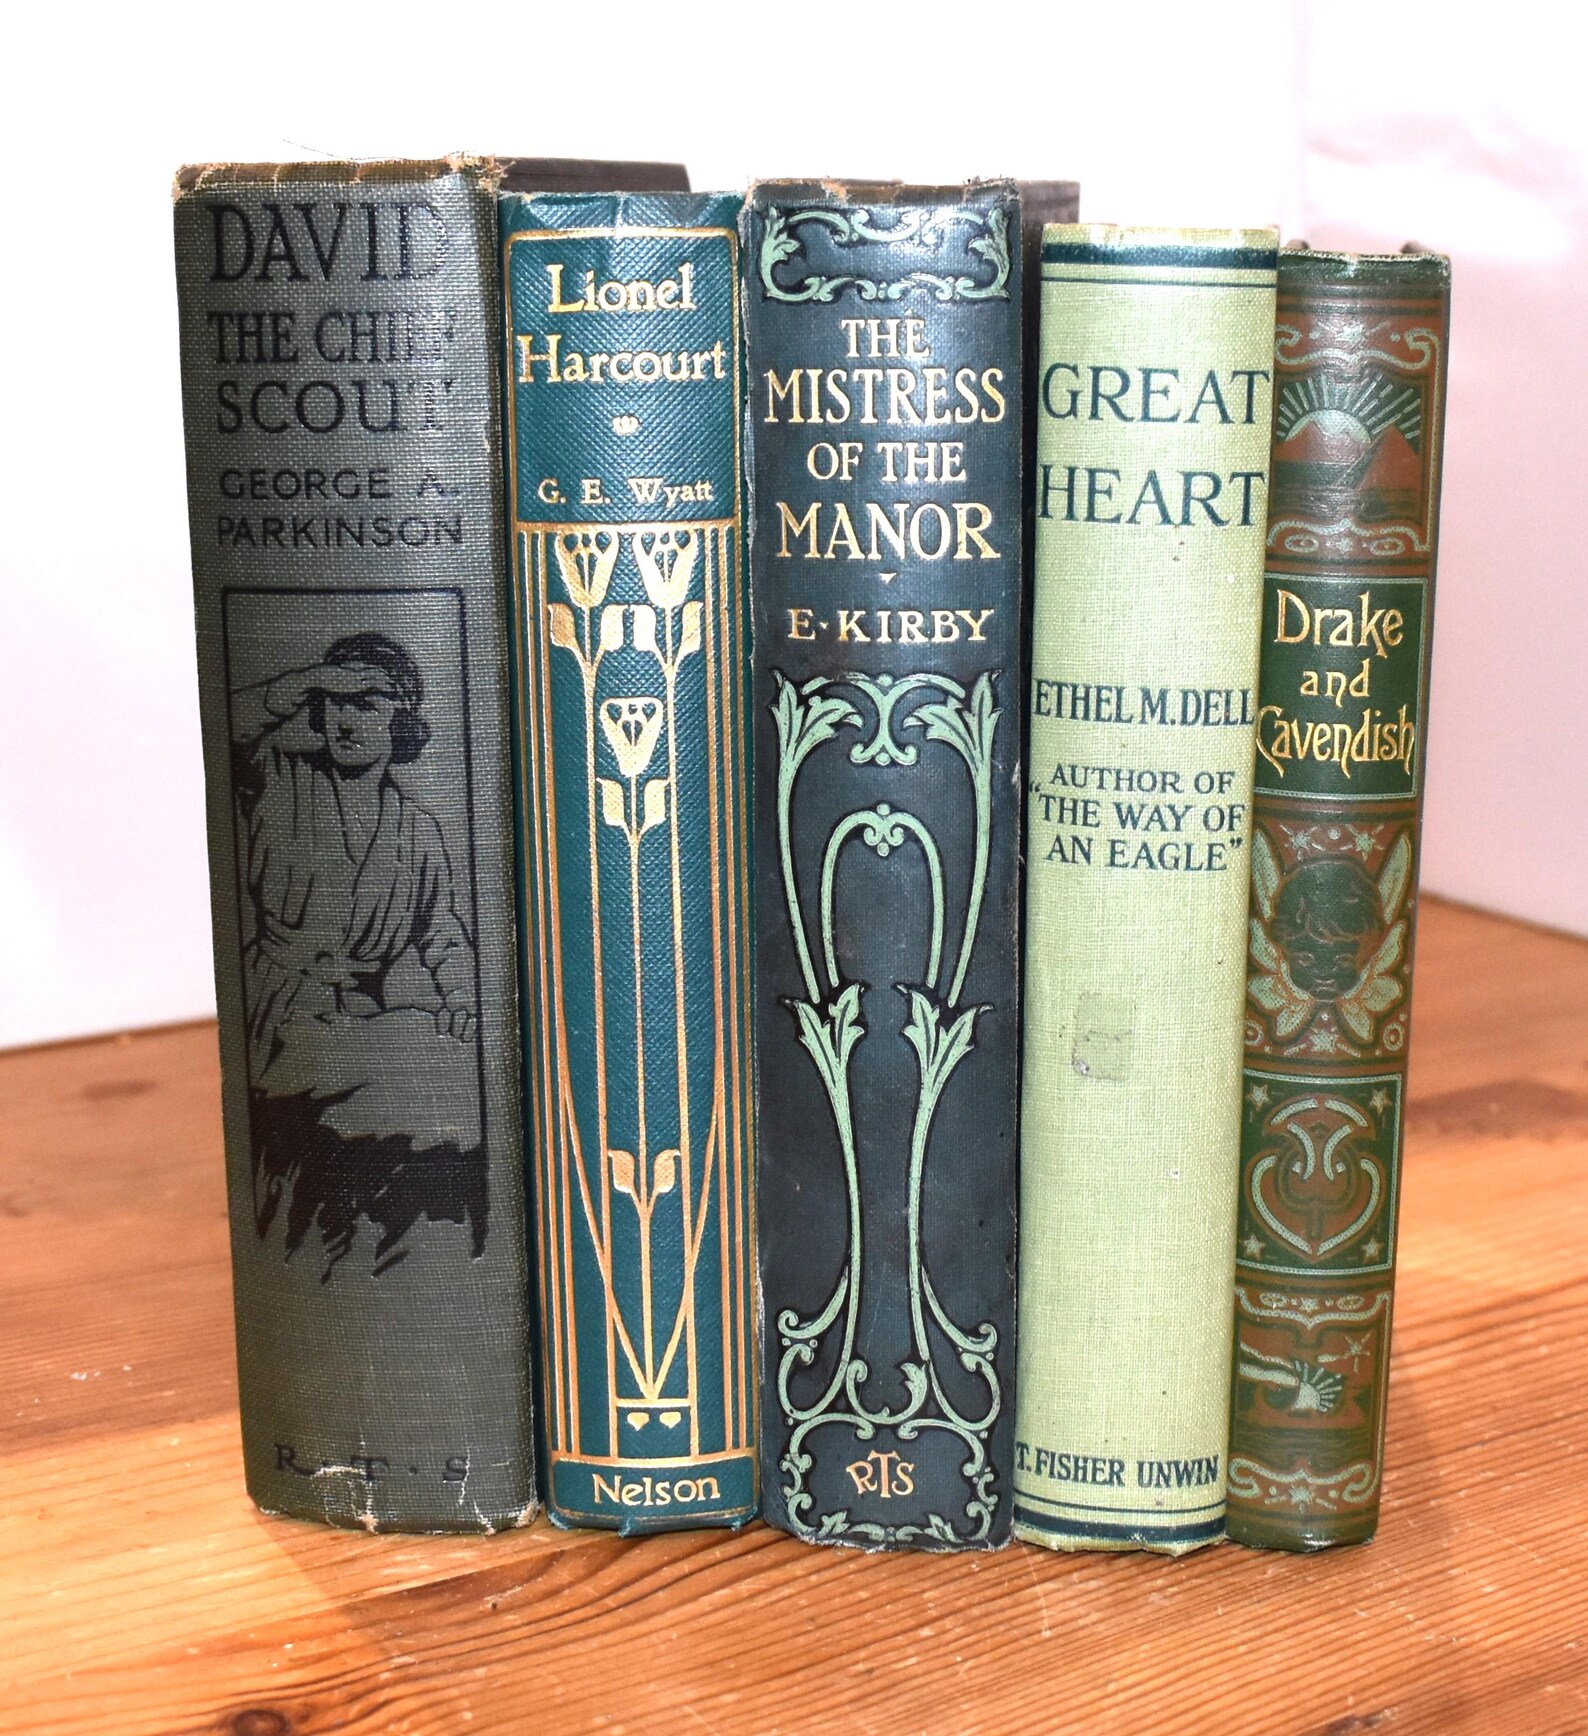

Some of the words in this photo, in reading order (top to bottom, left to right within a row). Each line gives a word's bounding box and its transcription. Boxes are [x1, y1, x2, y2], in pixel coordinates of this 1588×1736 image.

[206, 201, 449, 281] DAVID
[547, 262, 696, 312] Lionel
[206, 312, 297, 363] THE
[315, 312, 456, 362] CHIEF
[517, 335, 726, 382] Harcourt
[841, 318, 930, 359] THE
[216, 379, 457, 433] SCOUT
[764, 367, 1005, 424] MISTRESS
[1042, 362, 1270, 424] GREAT
[220, 469, 393, 499] GEORGE
[807, 442, 863, 480] OF
[877, 441, 966, 482] THE
[538, 479, 566, 503] G.
[581, 479, 611, 504] E.
[627, 478, 713, 508] Wyatt
[1038, 463, 1266, 526] HEART
[219, 515, 464, 547] PARKINSON
[776, 502, 1001, 560] MANOR
[1274, 589, 1403, 659] Drake
[1034, 678, 1133, 724] ETHEL
[1300, 658, 1370, 708] and
[1256, 704, 1415, 779] Cavendish
[1050, 763, 1184, 794] AUTHOR
[1194, 771, 1235, 794] OF
[1113, 802, 1193, 832] WAY
[1202, 804, 1245, 832] OF
[1045, 835, 1093, 865] AN
[592, 1473, 720, 1506] Nelson
[846, 1449, 914, 1498] RTS
[1136, 1454, 1219, 1489] UNWIN
